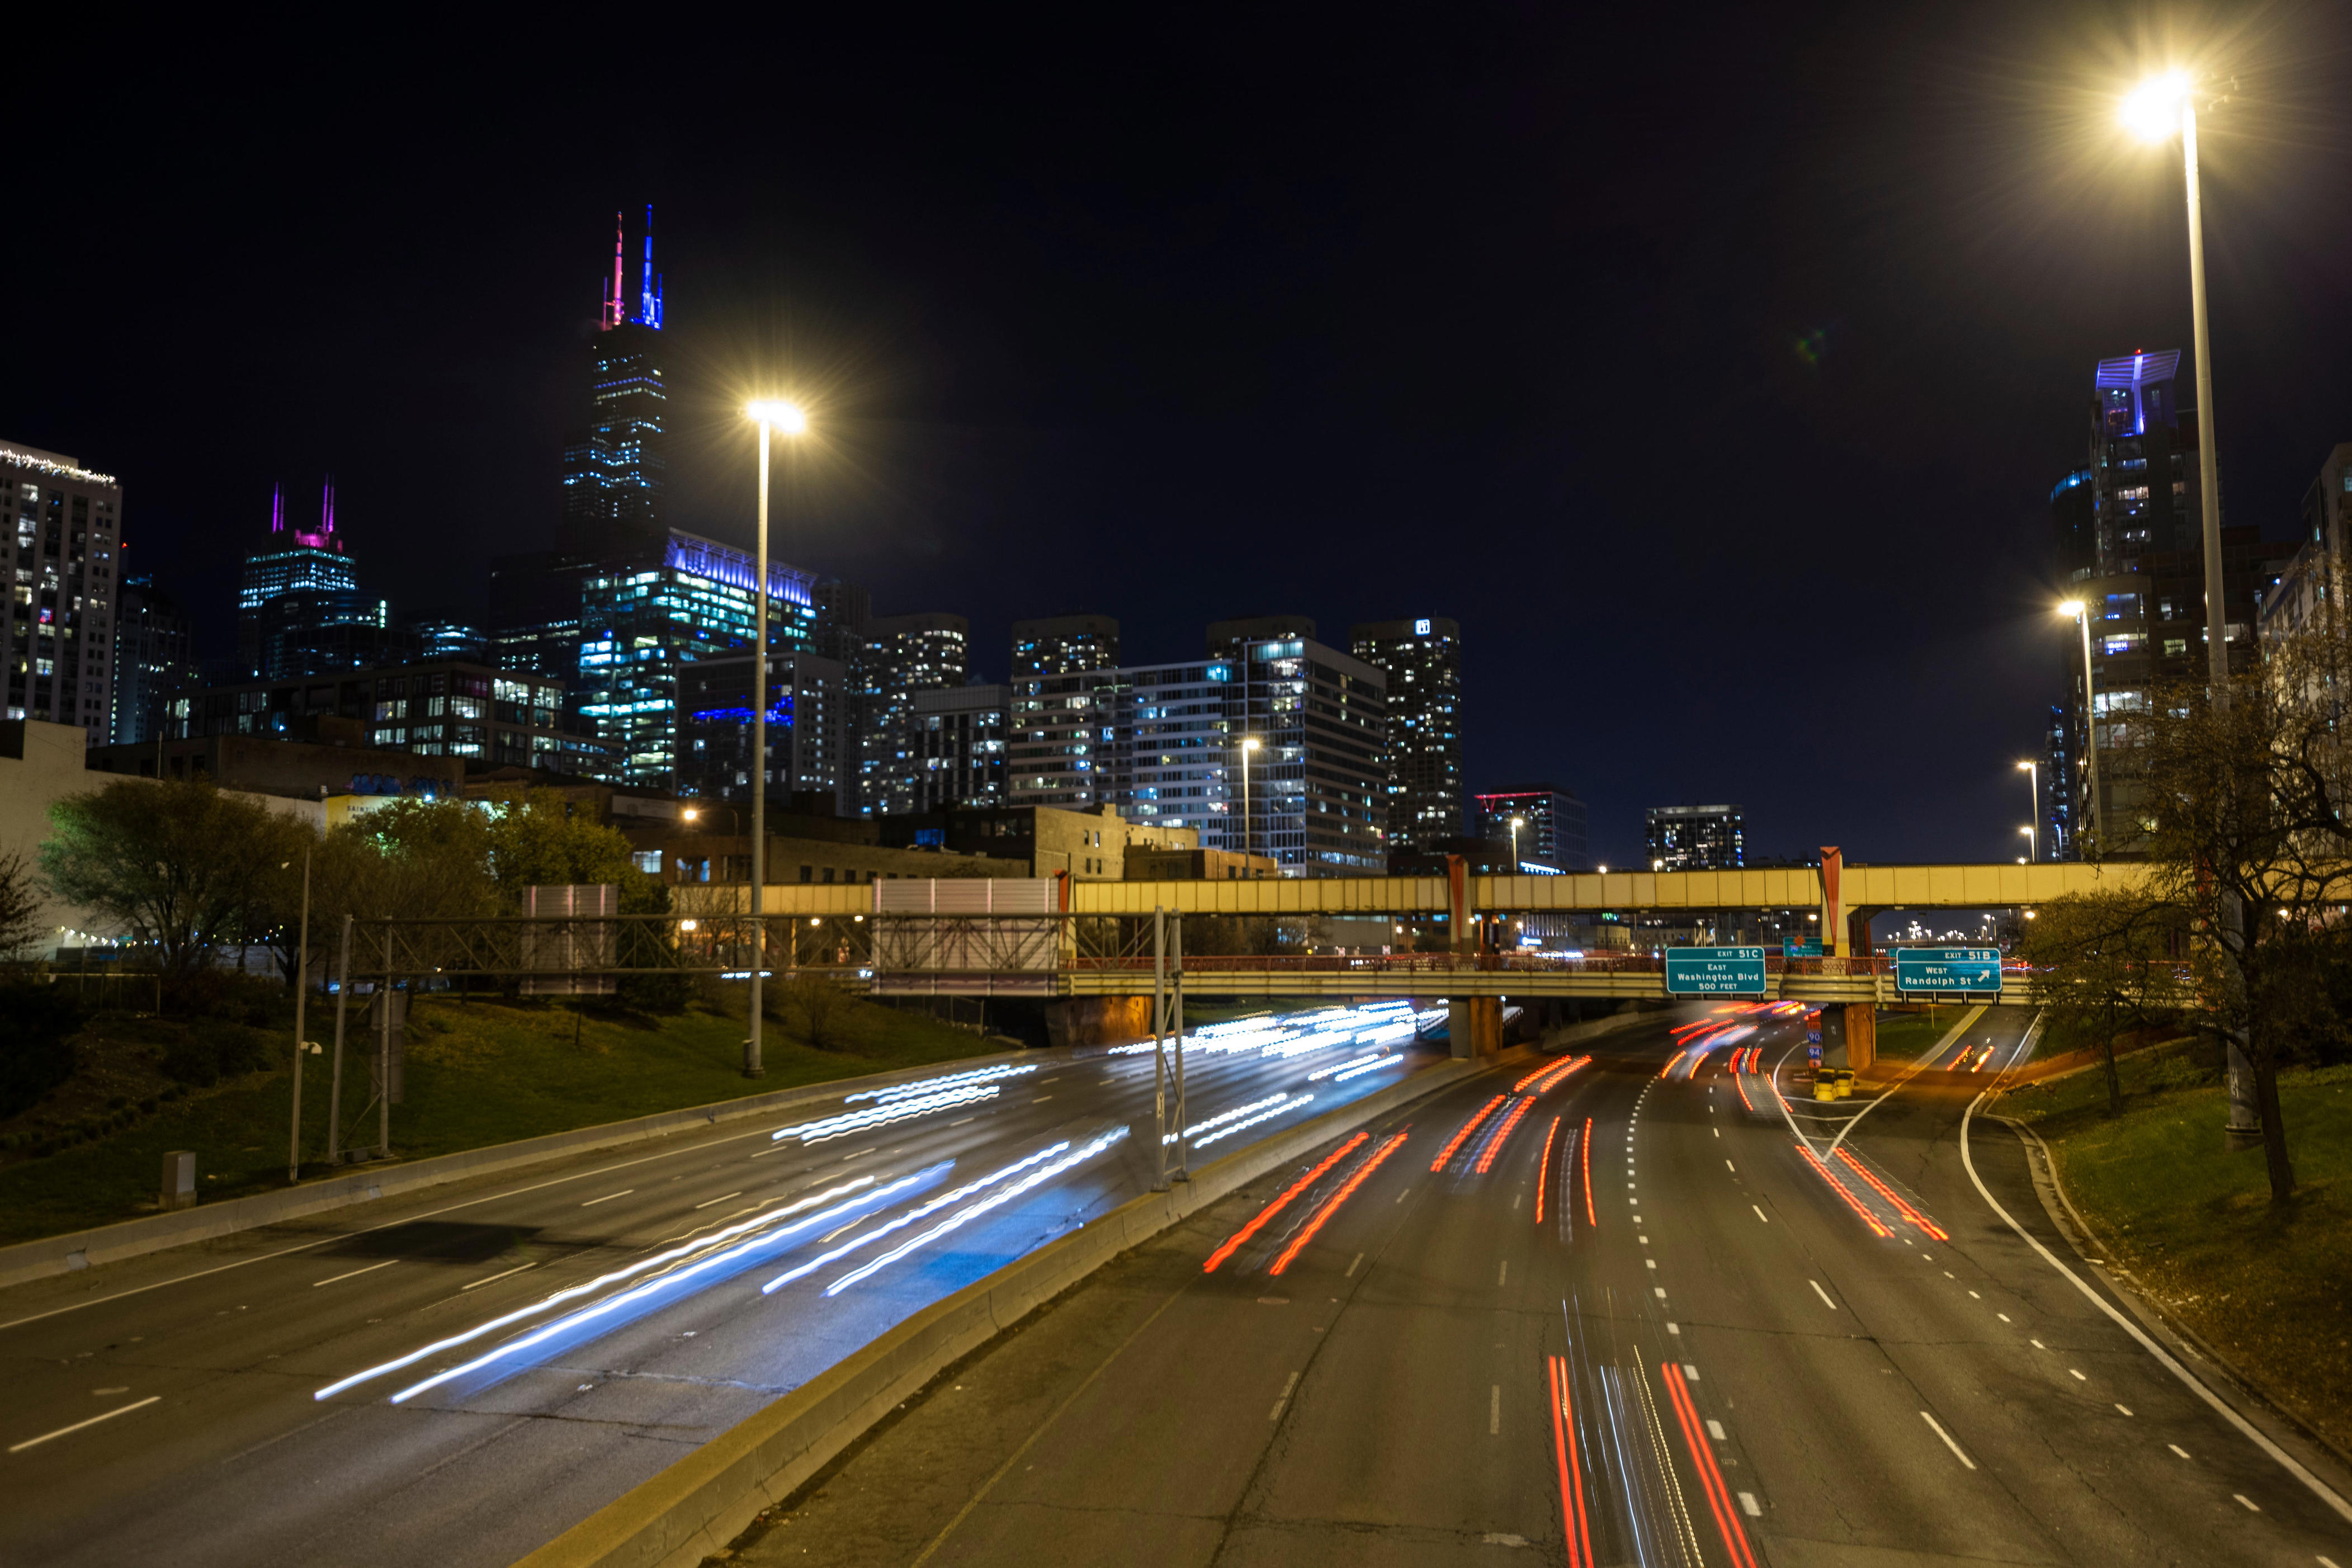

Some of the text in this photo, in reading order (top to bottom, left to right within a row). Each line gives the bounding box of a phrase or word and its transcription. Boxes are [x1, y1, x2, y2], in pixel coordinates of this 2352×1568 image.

[1739, 950, 1758, 958] 51C
[1968, 951, 1991, 960] 51B
[1678, 973, 1733, 983] Washington
[1905, 977, 1955, 986] Randolph
